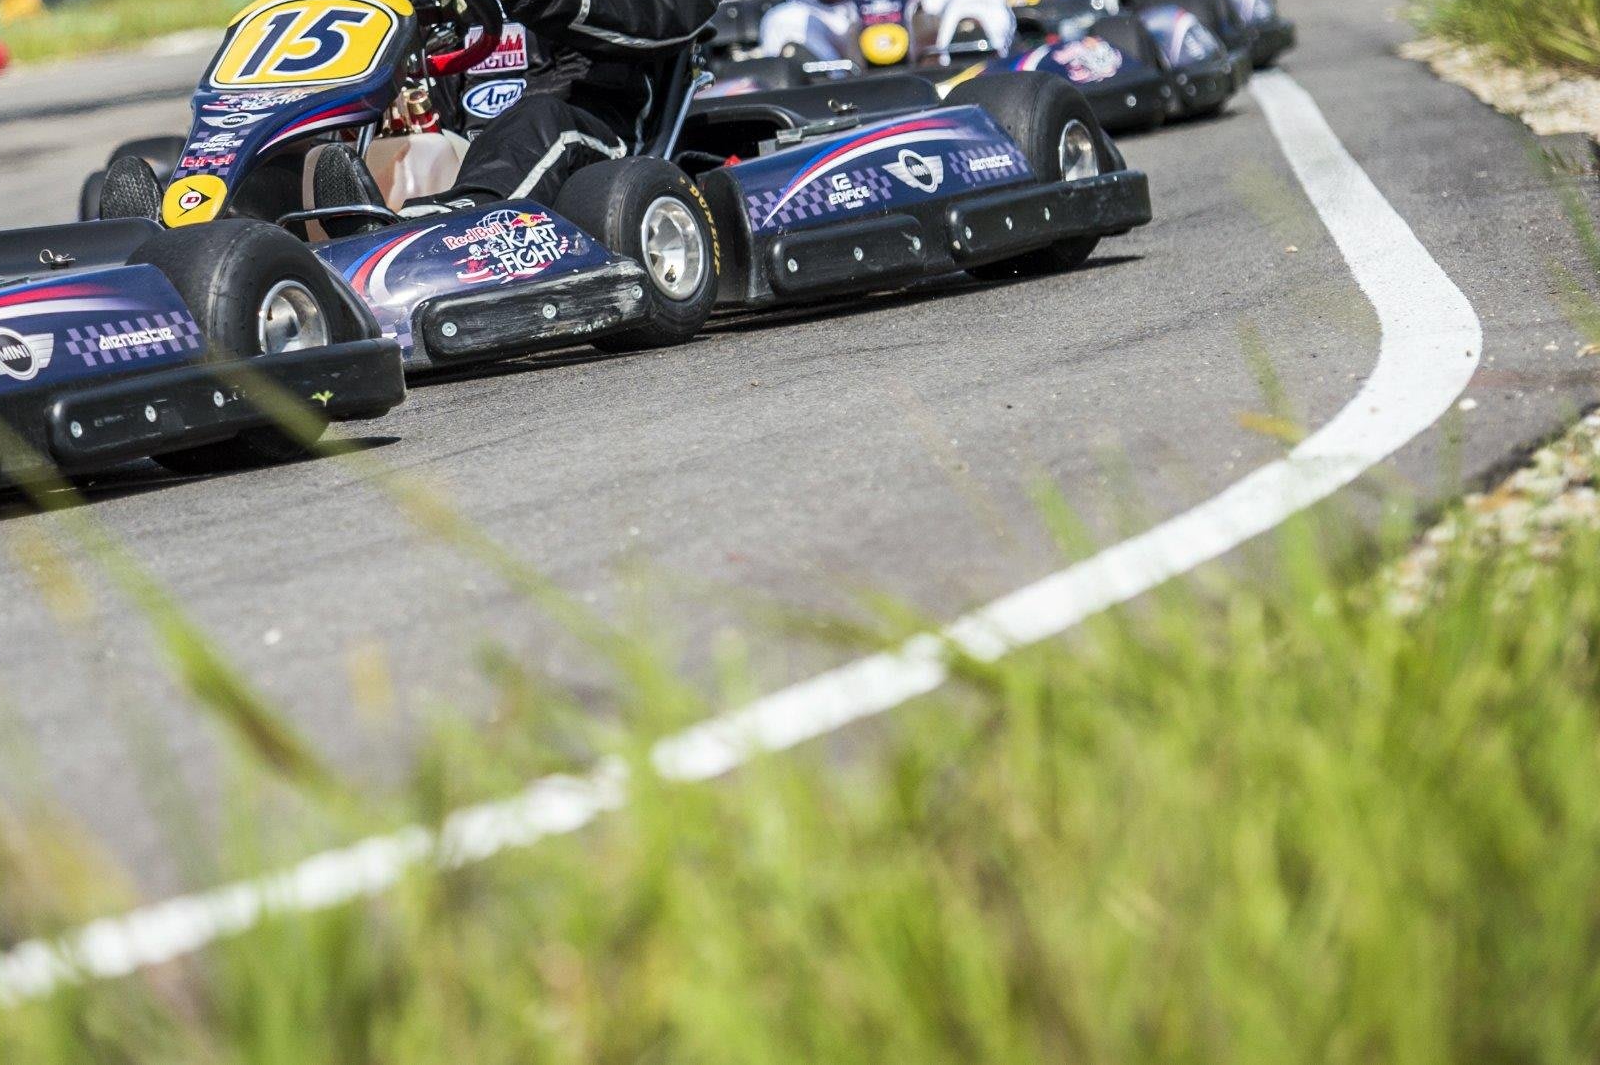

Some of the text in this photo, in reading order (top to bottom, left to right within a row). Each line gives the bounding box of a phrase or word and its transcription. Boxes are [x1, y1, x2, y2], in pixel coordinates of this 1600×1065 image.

[236, 7, 373, 78] 15
[829, 185, 871, 206] EDIFICE
[442, 221, 507, 250] Red Bull
[498, 223, 559, 250] KART
[499, 240, 562, 274] FIGHT
